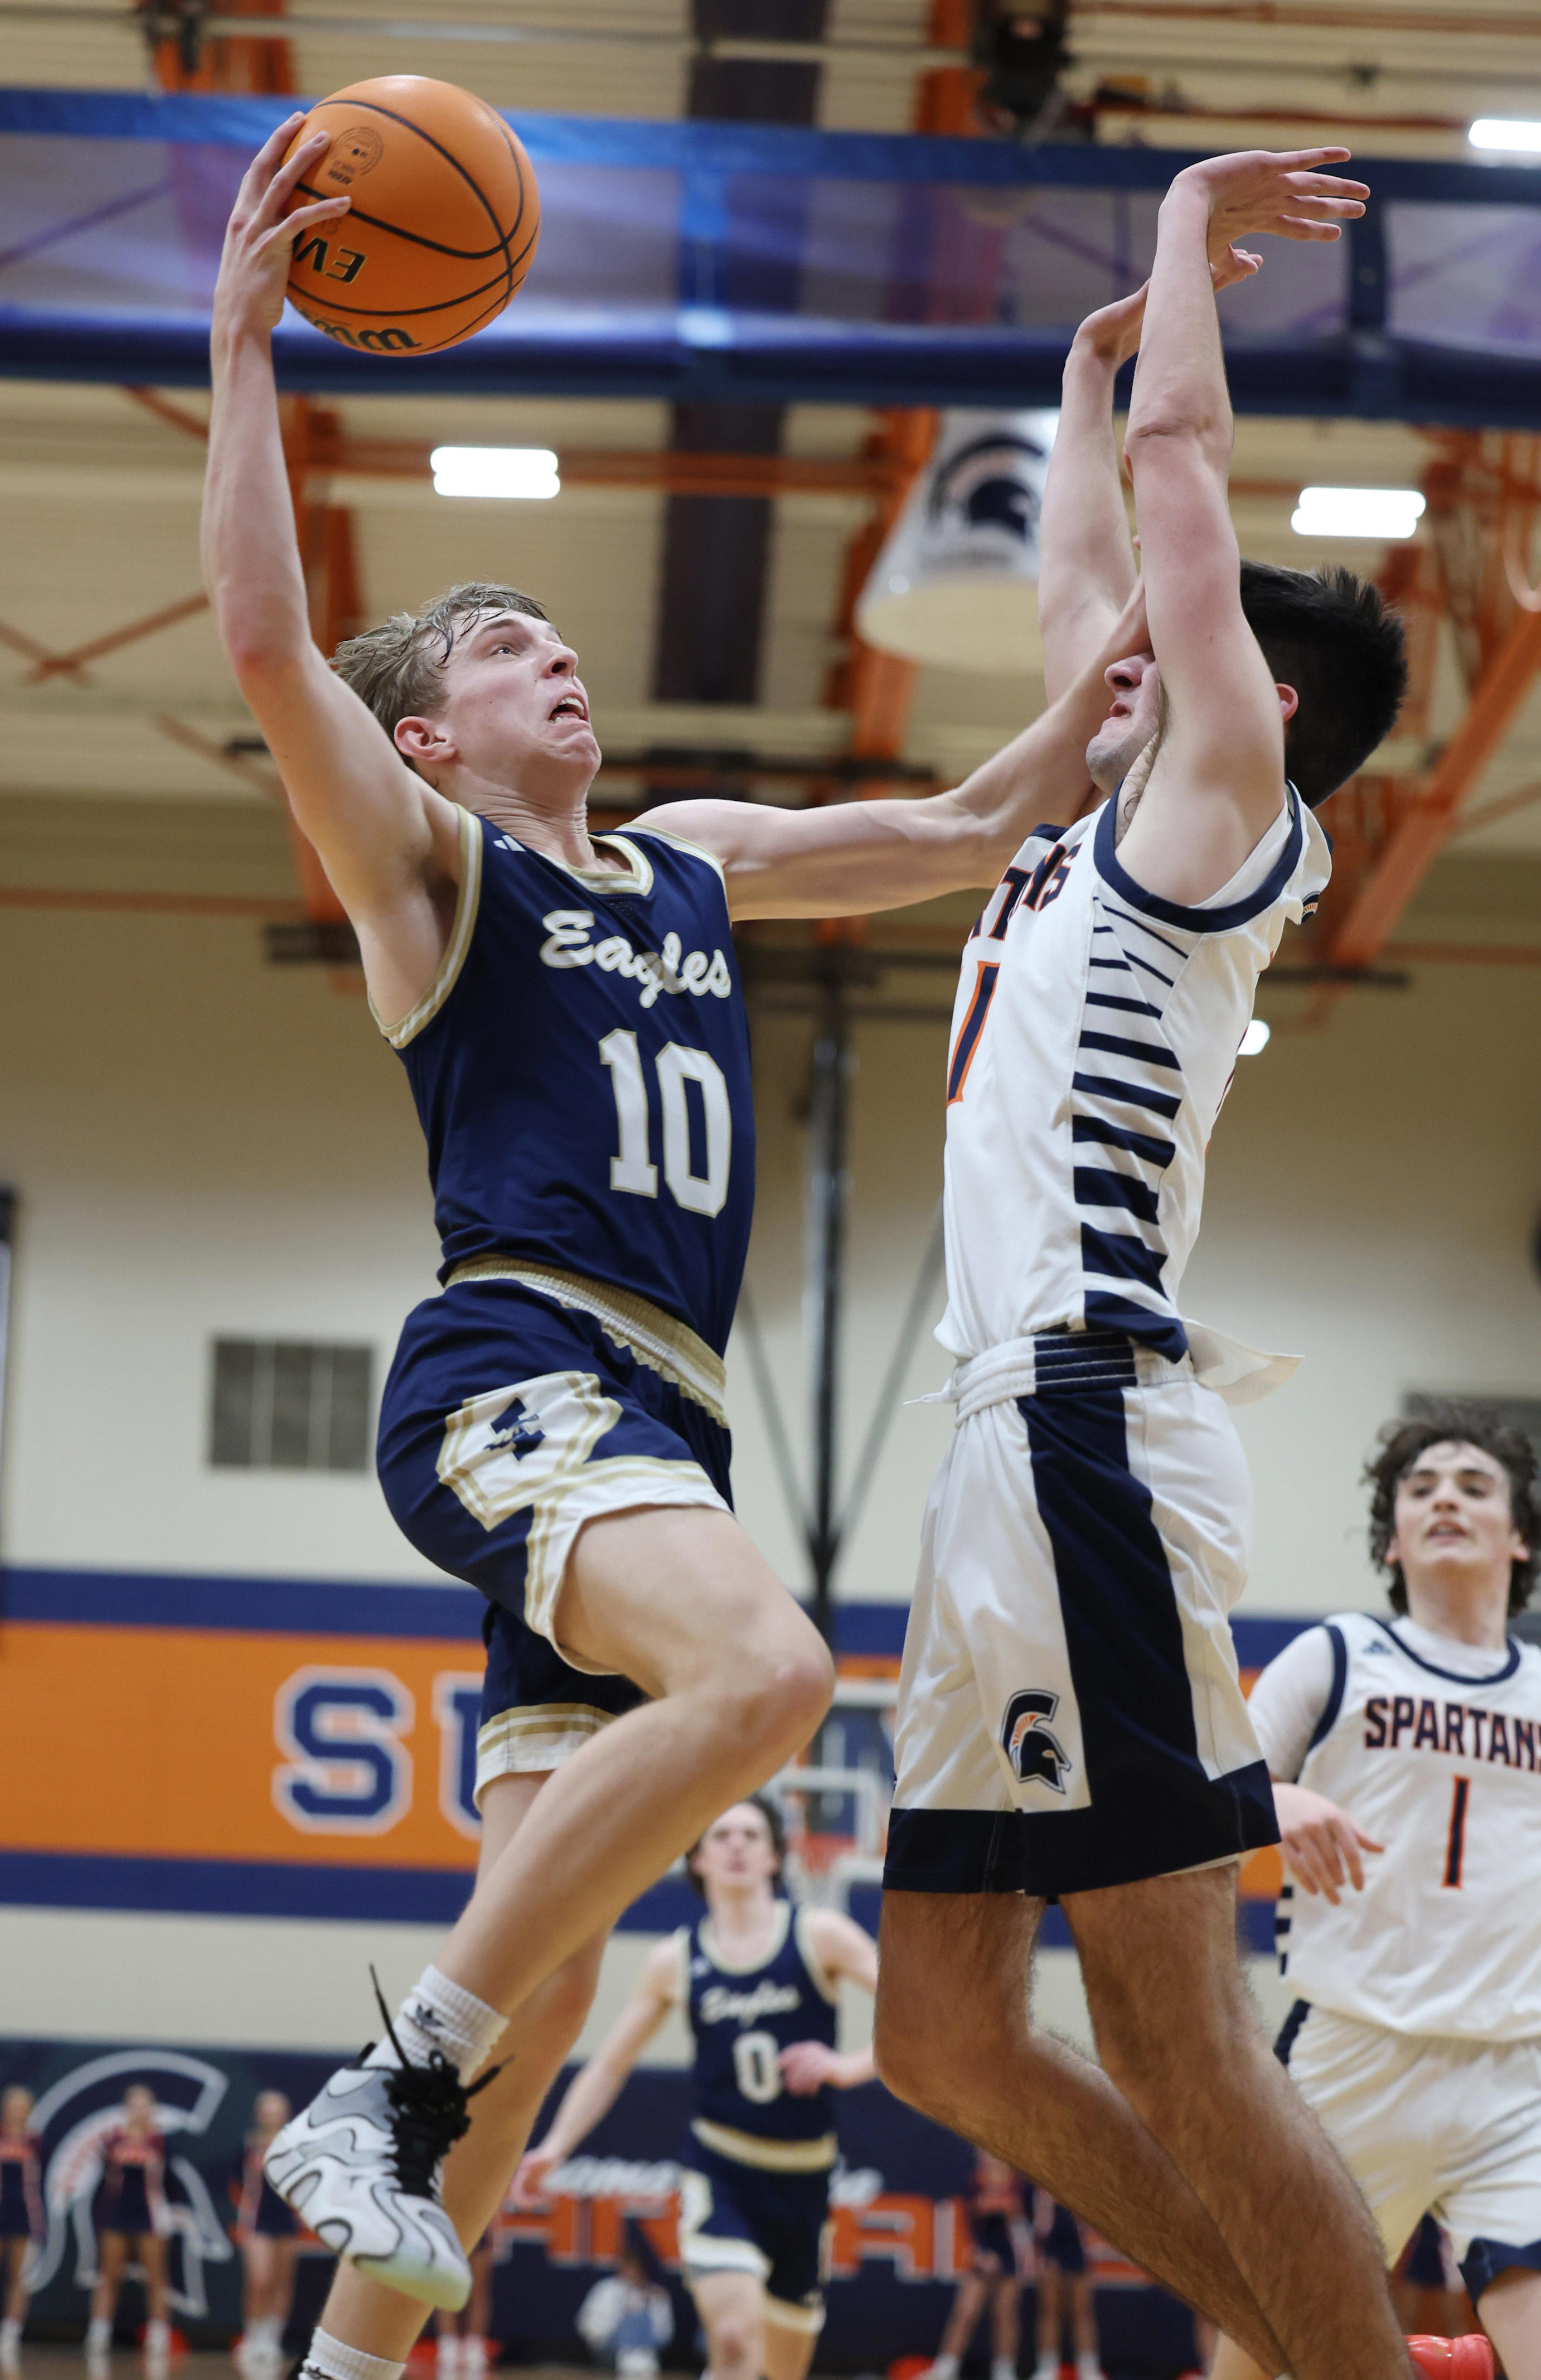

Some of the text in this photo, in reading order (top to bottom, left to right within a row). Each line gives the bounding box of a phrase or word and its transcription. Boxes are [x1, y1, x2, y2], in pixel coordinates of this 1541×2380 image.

[292, 230, 366, 284] EV
[539, 910, 732, 1008] Eagles
[599, 1027, 733, 1219] 10
[1440, 1775, 1470, 1889] 1
[733, 2030, 782, 2105] 0
